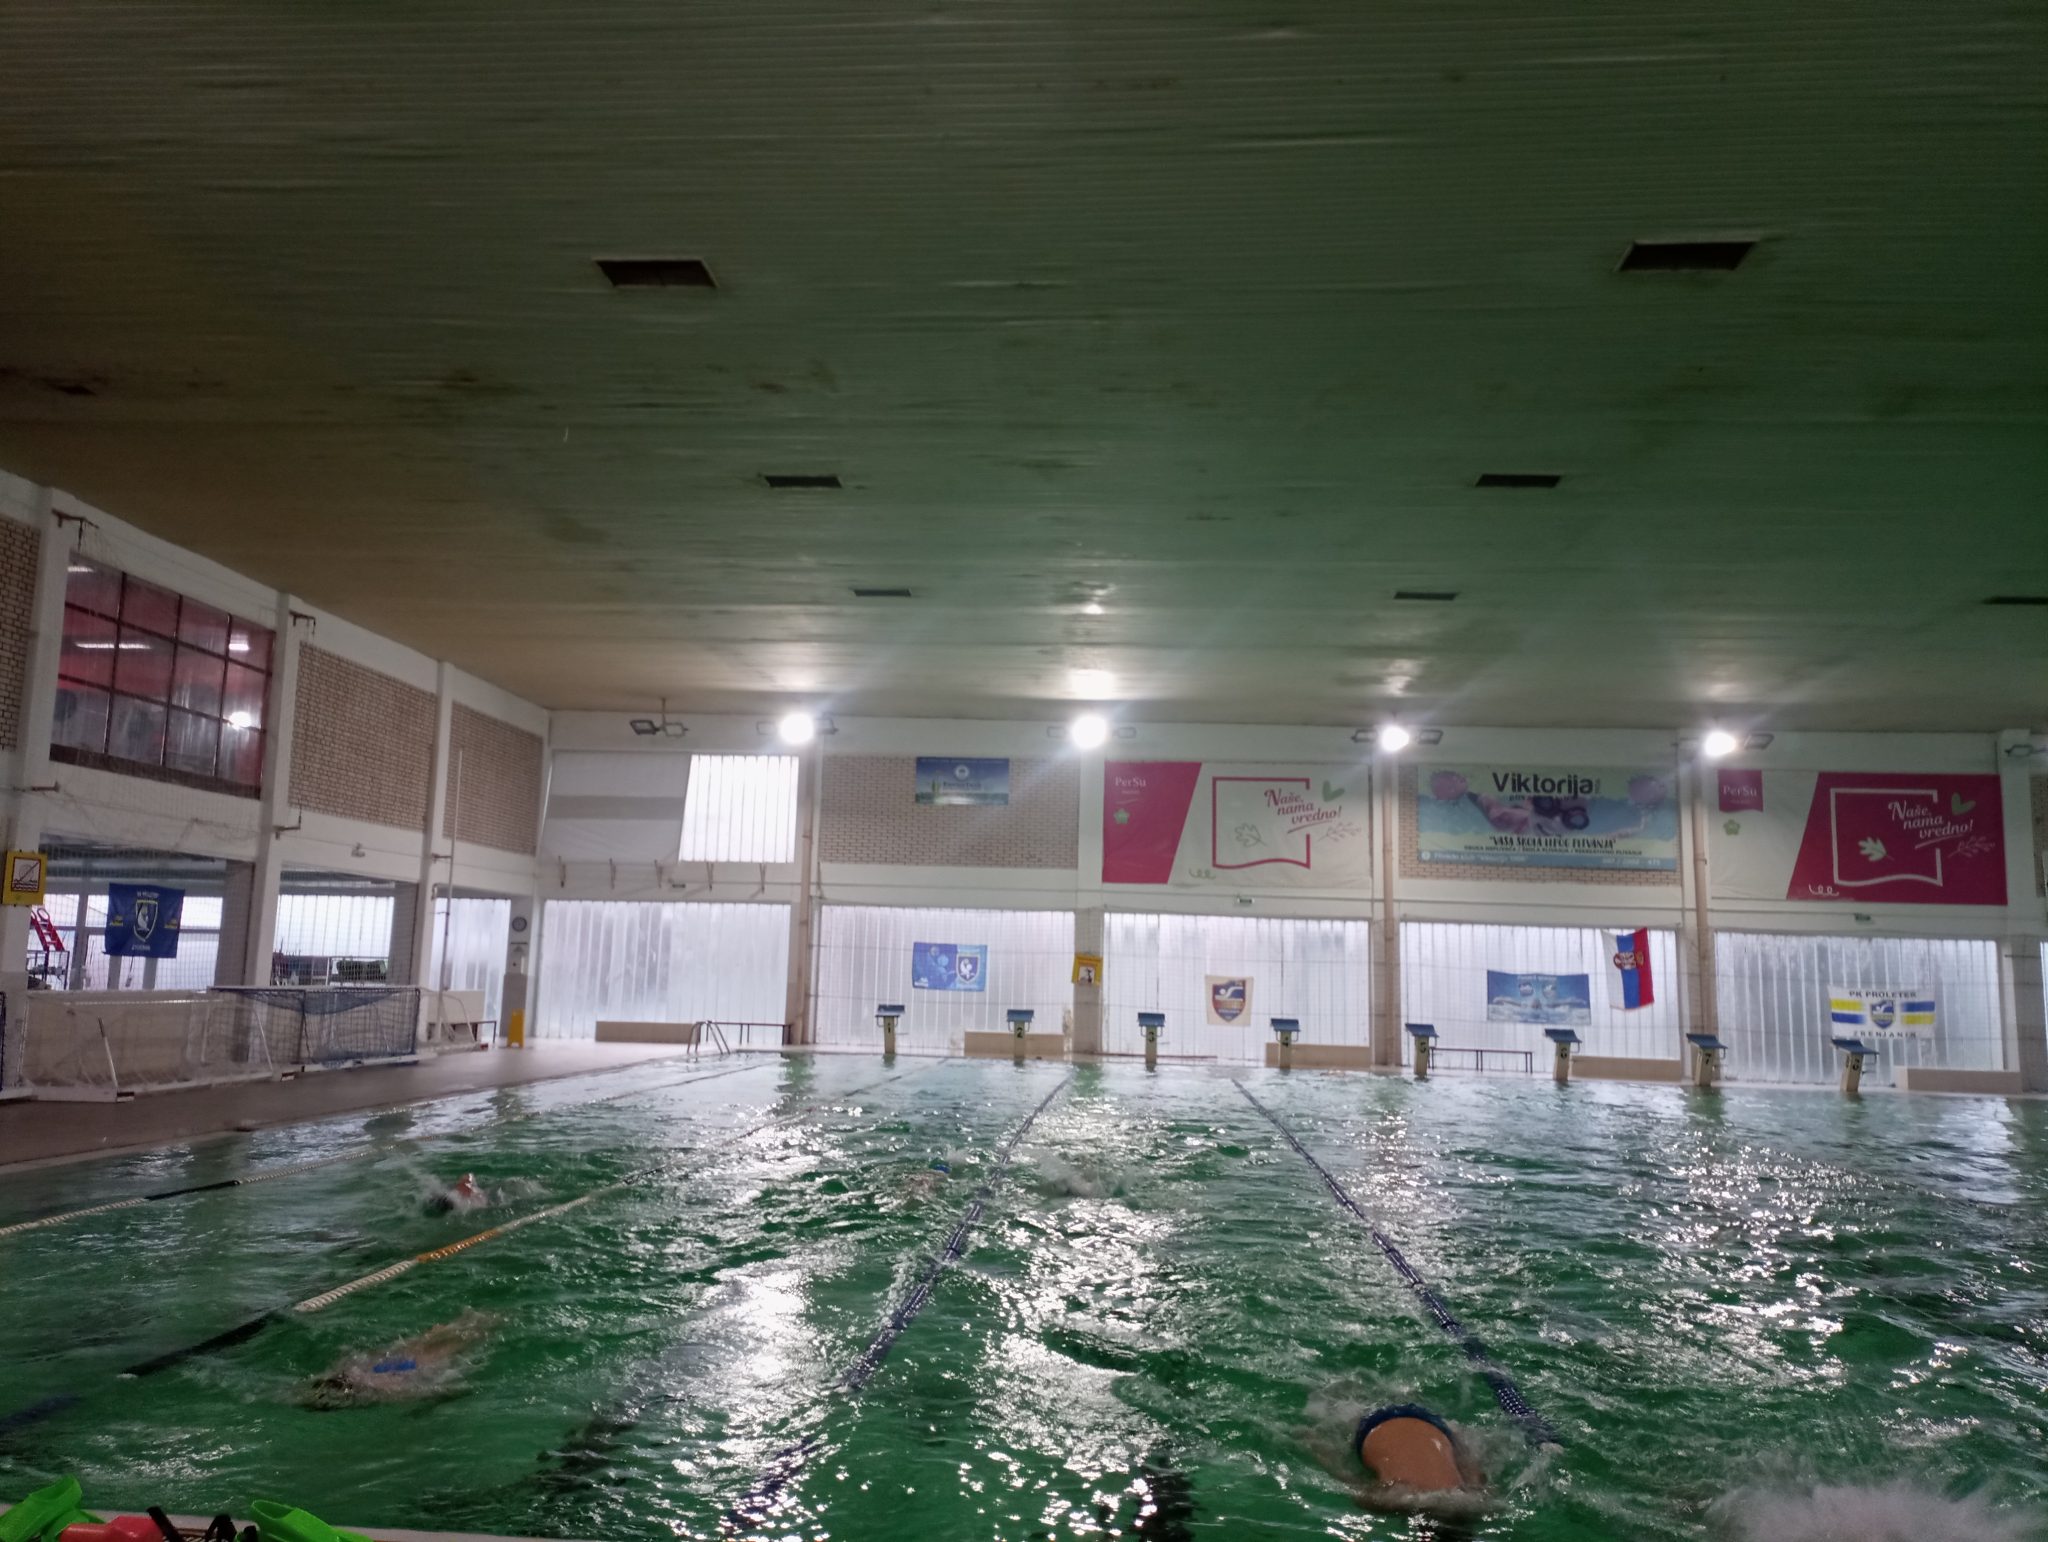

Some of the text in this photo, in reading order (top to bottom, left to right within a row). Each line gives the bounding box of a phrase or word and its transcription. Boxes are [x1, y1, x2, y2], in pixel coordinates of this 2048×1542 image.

[1115, 776, 1147, 788] PerSu
[1492, 772, 1593, 799] Viktorija
[1722, 784, 1757, 797] PerSu
[1277, 802, 1314, 816] nama
[1291, 804, 1342, 825] vredno!
[1903, 815, 1943, 830] nama
[1919, 818, 1973, 839] vredno!
[1016, 1026, 1024, 1039] 2
